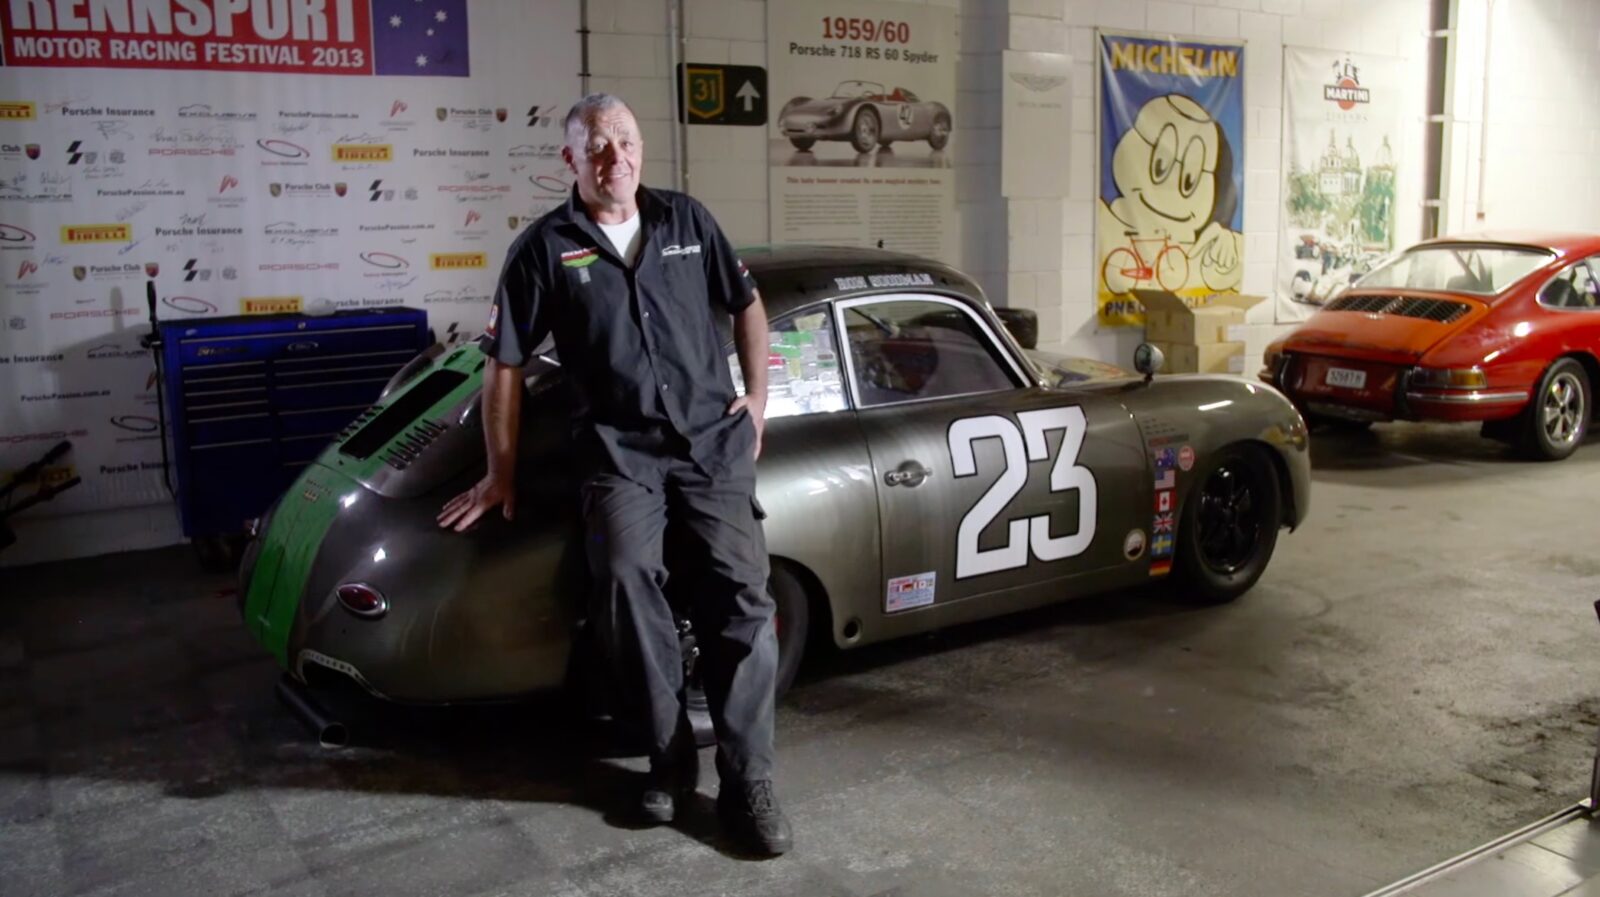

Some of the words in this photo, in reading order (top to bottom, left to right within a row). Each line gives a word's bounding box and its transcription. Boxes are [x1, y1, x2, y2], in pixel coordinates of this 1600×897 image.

[822, 16, 910, 44] 1959/60
[14, 37, 101, 58] MOTOR
[110, 39, 196, 62] RACING
[204, 42, 304, 65] FESTIVAL
[312, 47, 364, 67] 2013
[789, 42, 836, 57] Porsche
[841, 45, 861, 58] 718
[866, 47, 881, 60] RS
[885, 48, 899, 61] 60
[903, 50, 938, 63] Spyder
[1111, 41, 1238, 78] MICHELIN
[694, 78, 717, 101] 31
[1326, 87, 1368, 102] MARTINI
[62, 107, 102, 116] Porsche
[106, 107, 155, 116] Insurance
[337, 147, 388, 159] PIRELLI
[413, 148, 446, 157] Porsche
[449, 148, 489, 157] Insurance
[67, 226, 126, 241] PIRELLI
[156, 227, 193, 237] Porsche
[197, 227, 243, 237] Insurance
[258, 263, 340, 271] PORSCHE
[435, 254, 483, 268] PIRELLI
[90, 265, 122, 273] Porsche
[124, 264, 140, 273] Club
[50, 308, 140, 320] PORSCHE
[14, 354, 64, 363] Insurance
[100, 463, 138, 475] Porsche
[947, 404, 1098, 579] 23
